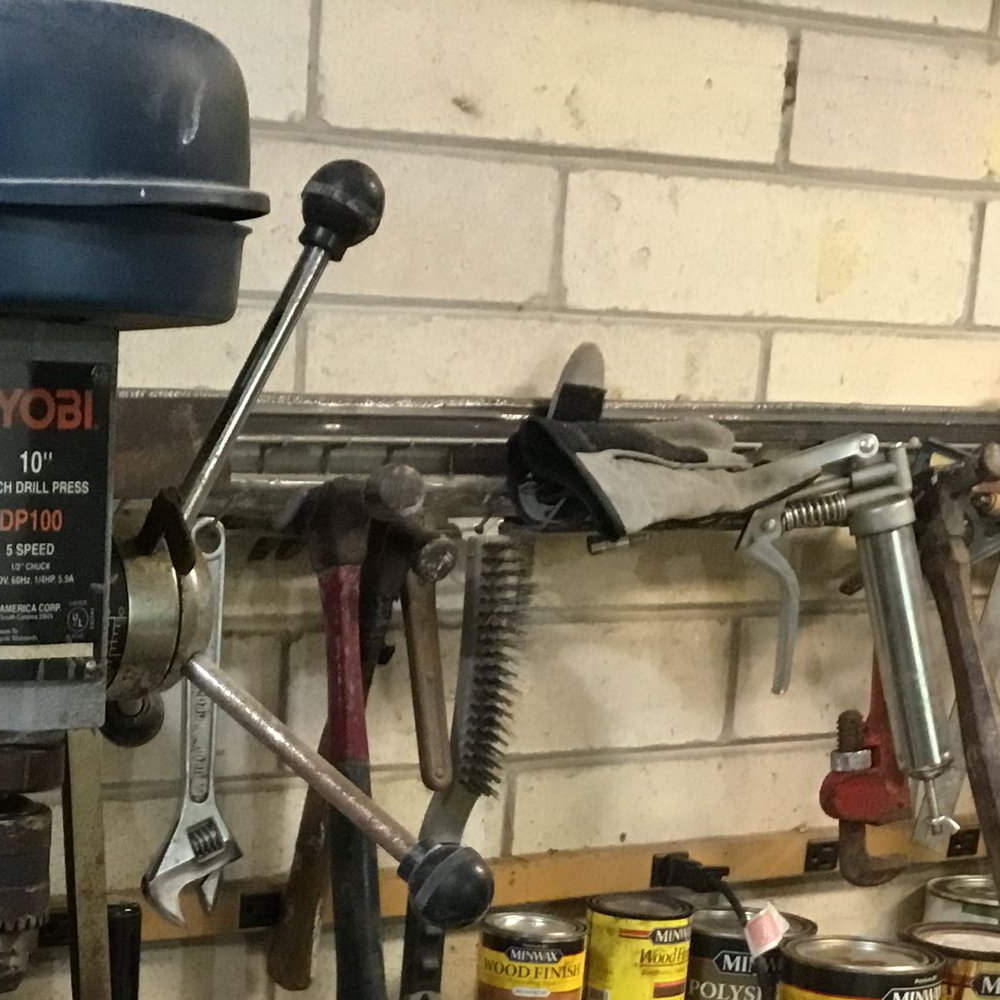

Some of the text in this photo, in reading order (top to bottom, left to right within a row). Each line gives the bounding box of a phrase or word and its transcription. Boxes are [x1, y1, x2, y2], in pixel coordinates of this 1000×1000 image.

[19, 451, 53, 473] 10"
[15, 481, 49, 494] DRILL
[52, 480, 90, 494] PRESS
[0, 509, 63, 531] DP100
[6, 543, 55, 556] 5 SPEED
[25, 562, 51, 571] CHUCK
[0, 604, 37, 613] AMERICA
[510, 948, 558, 962] MINWAX
[484, 957, 581, 980] WOOD FINISH
